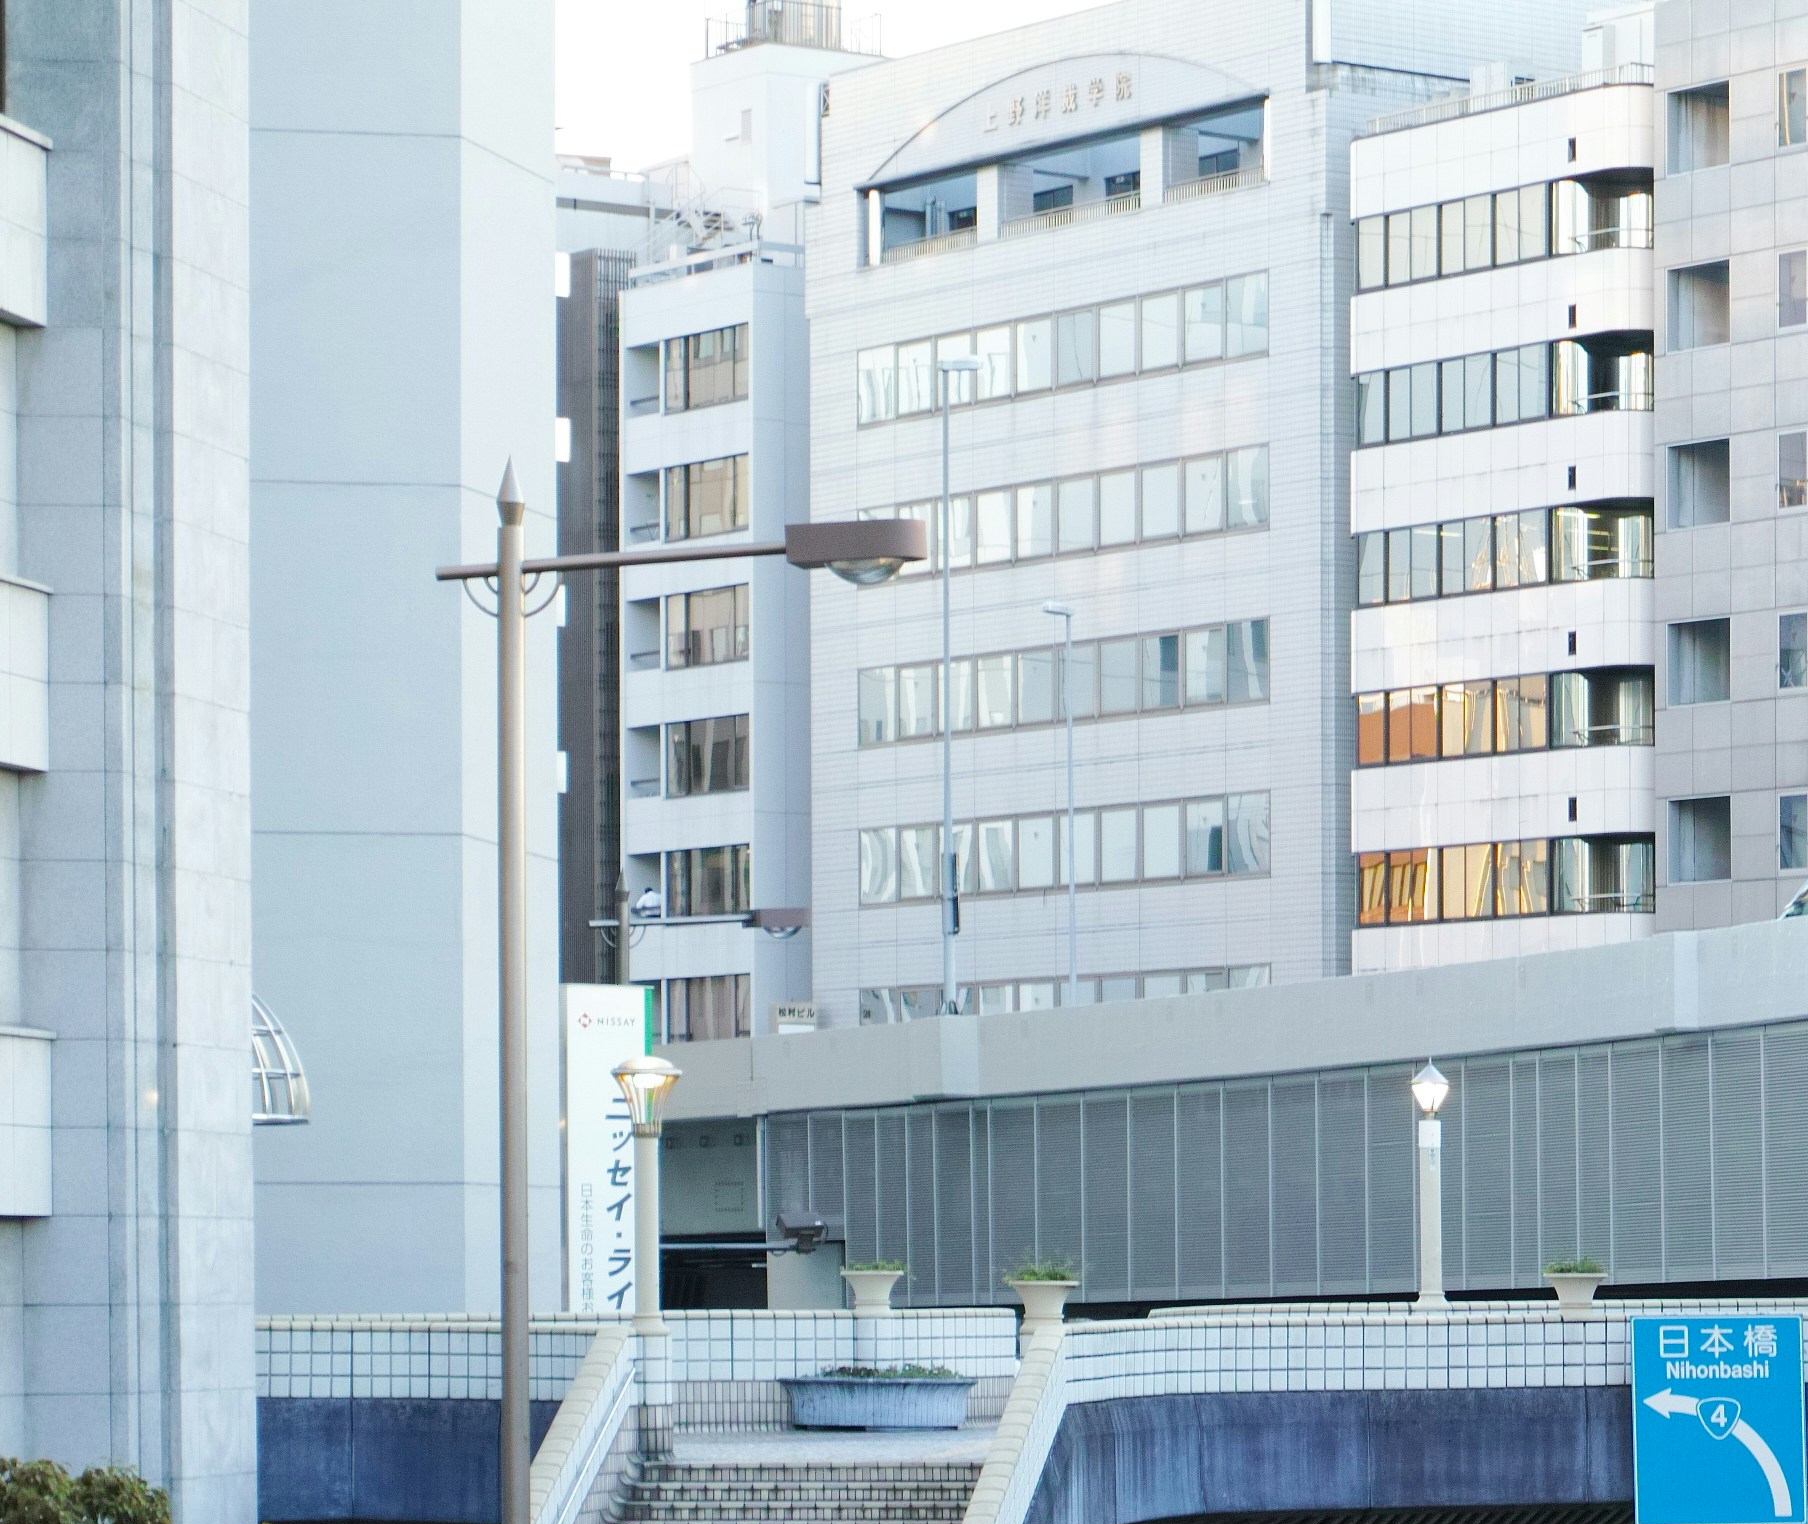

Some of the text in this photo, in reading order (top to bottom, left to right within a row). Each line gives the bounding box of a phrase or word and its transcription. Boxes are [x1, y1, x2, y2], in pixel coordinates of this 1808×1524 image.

[597, 1017, 635, 1028] NISSAY
[1659, 1324, 1777, 1358] 日本橋
[1666, 1361, 1769, 1379] Nihonbashi
[1710, 1404, 1728, 1428] 4
